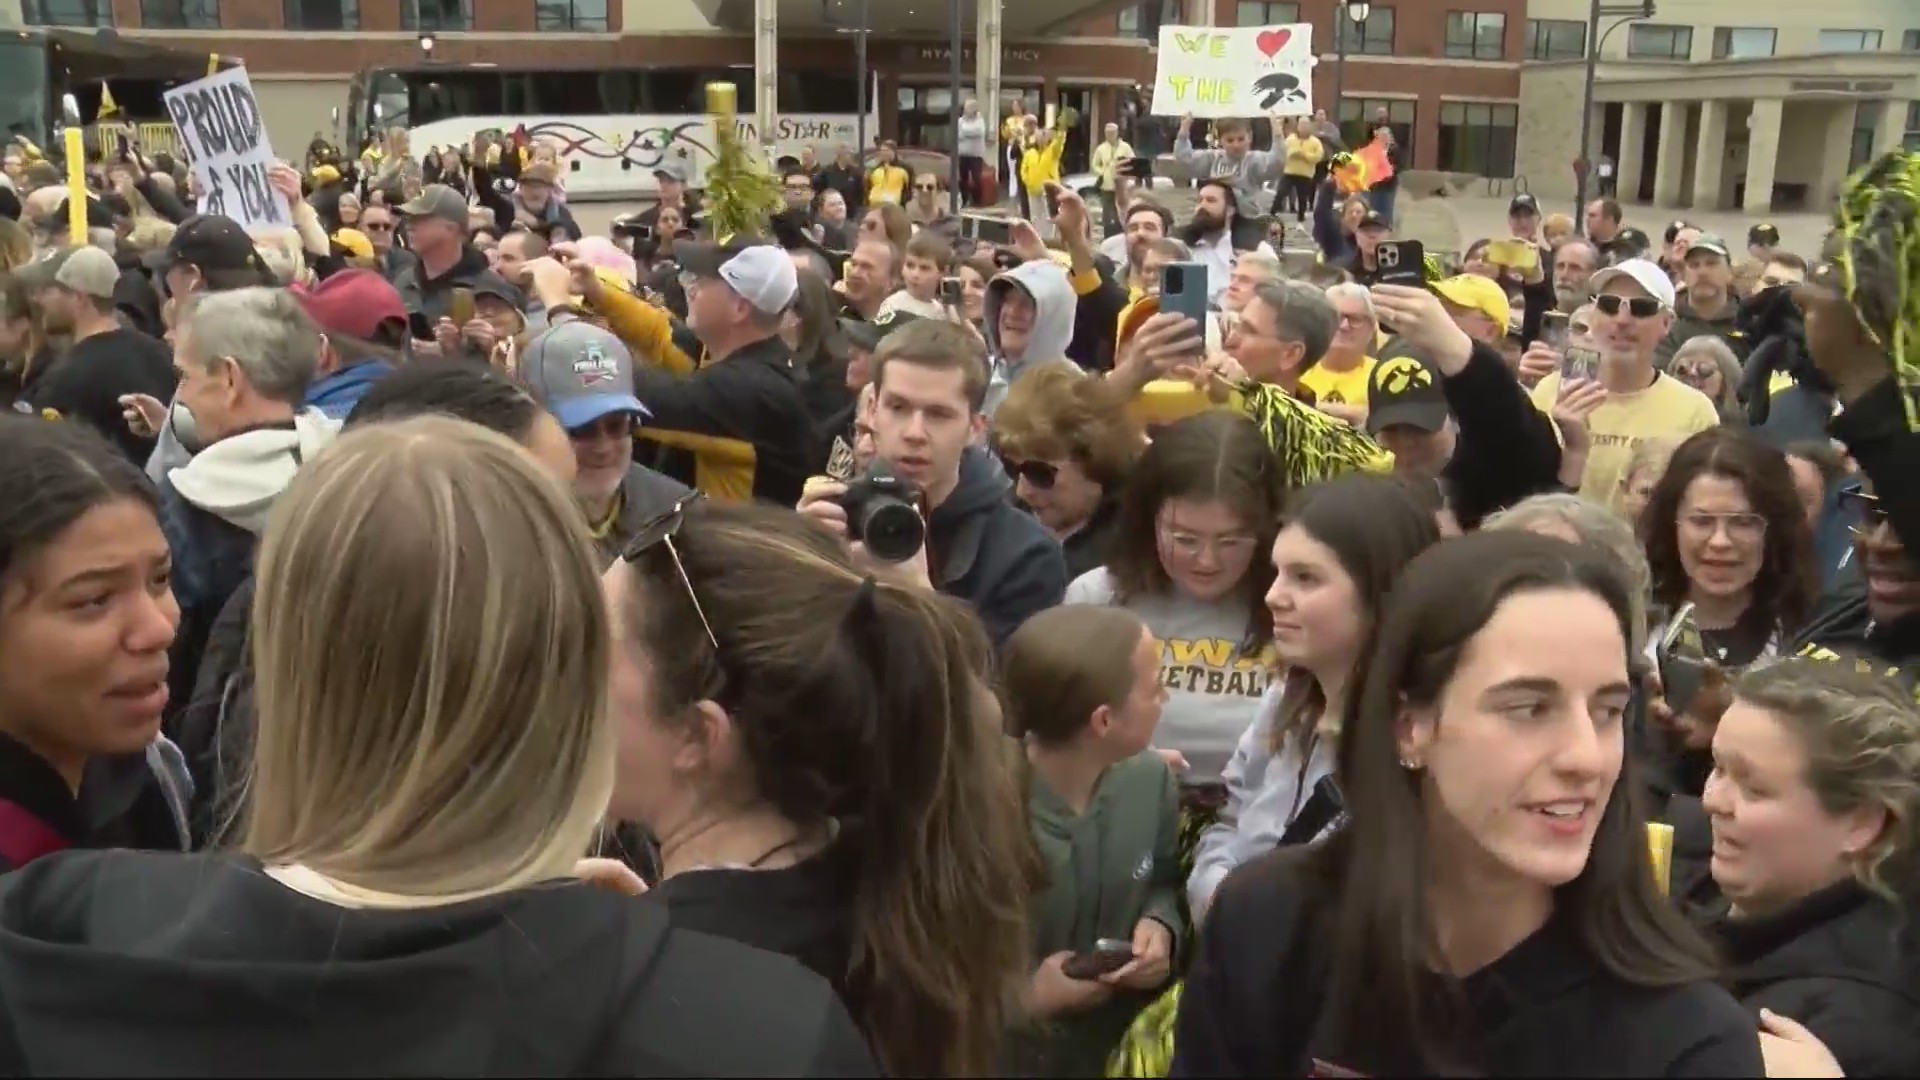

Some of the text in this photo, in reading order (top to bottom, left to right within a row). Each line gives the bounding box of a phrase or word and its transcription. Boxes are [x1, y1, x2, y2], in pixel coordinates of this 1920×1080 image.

[922, 48, 969, 59] HYAT
[1175, 33, 1230, 58] WE
[1169, 76, 1236, 104] THE
[169, 82, 261, 162] PROUD
[227, 163, 282, 224] YOU
